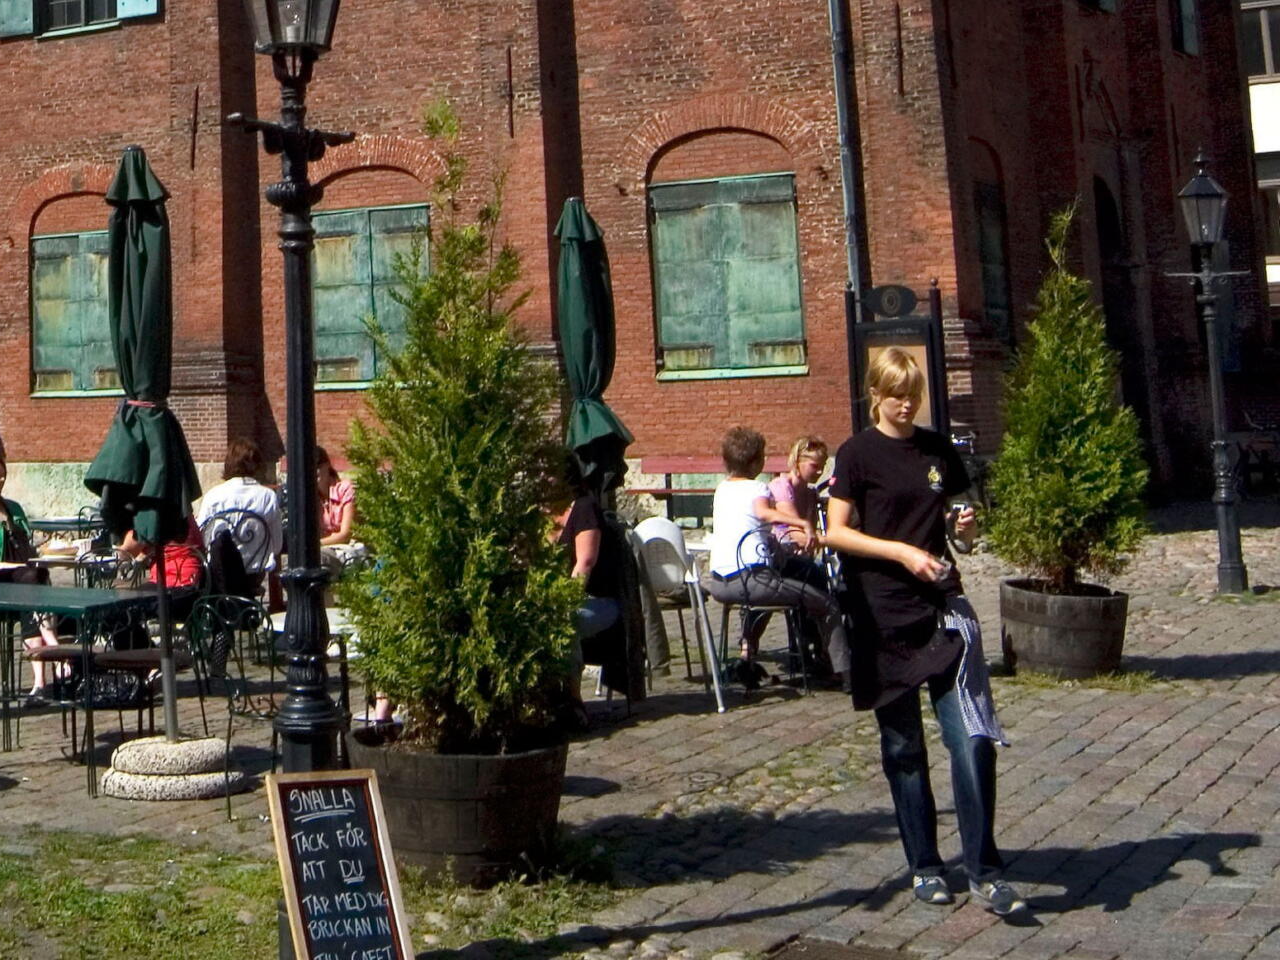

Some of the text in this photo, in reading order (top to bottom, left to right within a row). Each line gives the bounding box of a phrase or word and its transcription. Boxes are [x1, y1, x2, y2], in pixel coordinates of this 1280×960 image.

[291, 821, 368, 855] TACK FÖR
[302, 859, 363, 883] ATT DU
[302, 890, 390, 917] TAR MED DIG
[308, 917, 391, 940] BRICKAN IN
